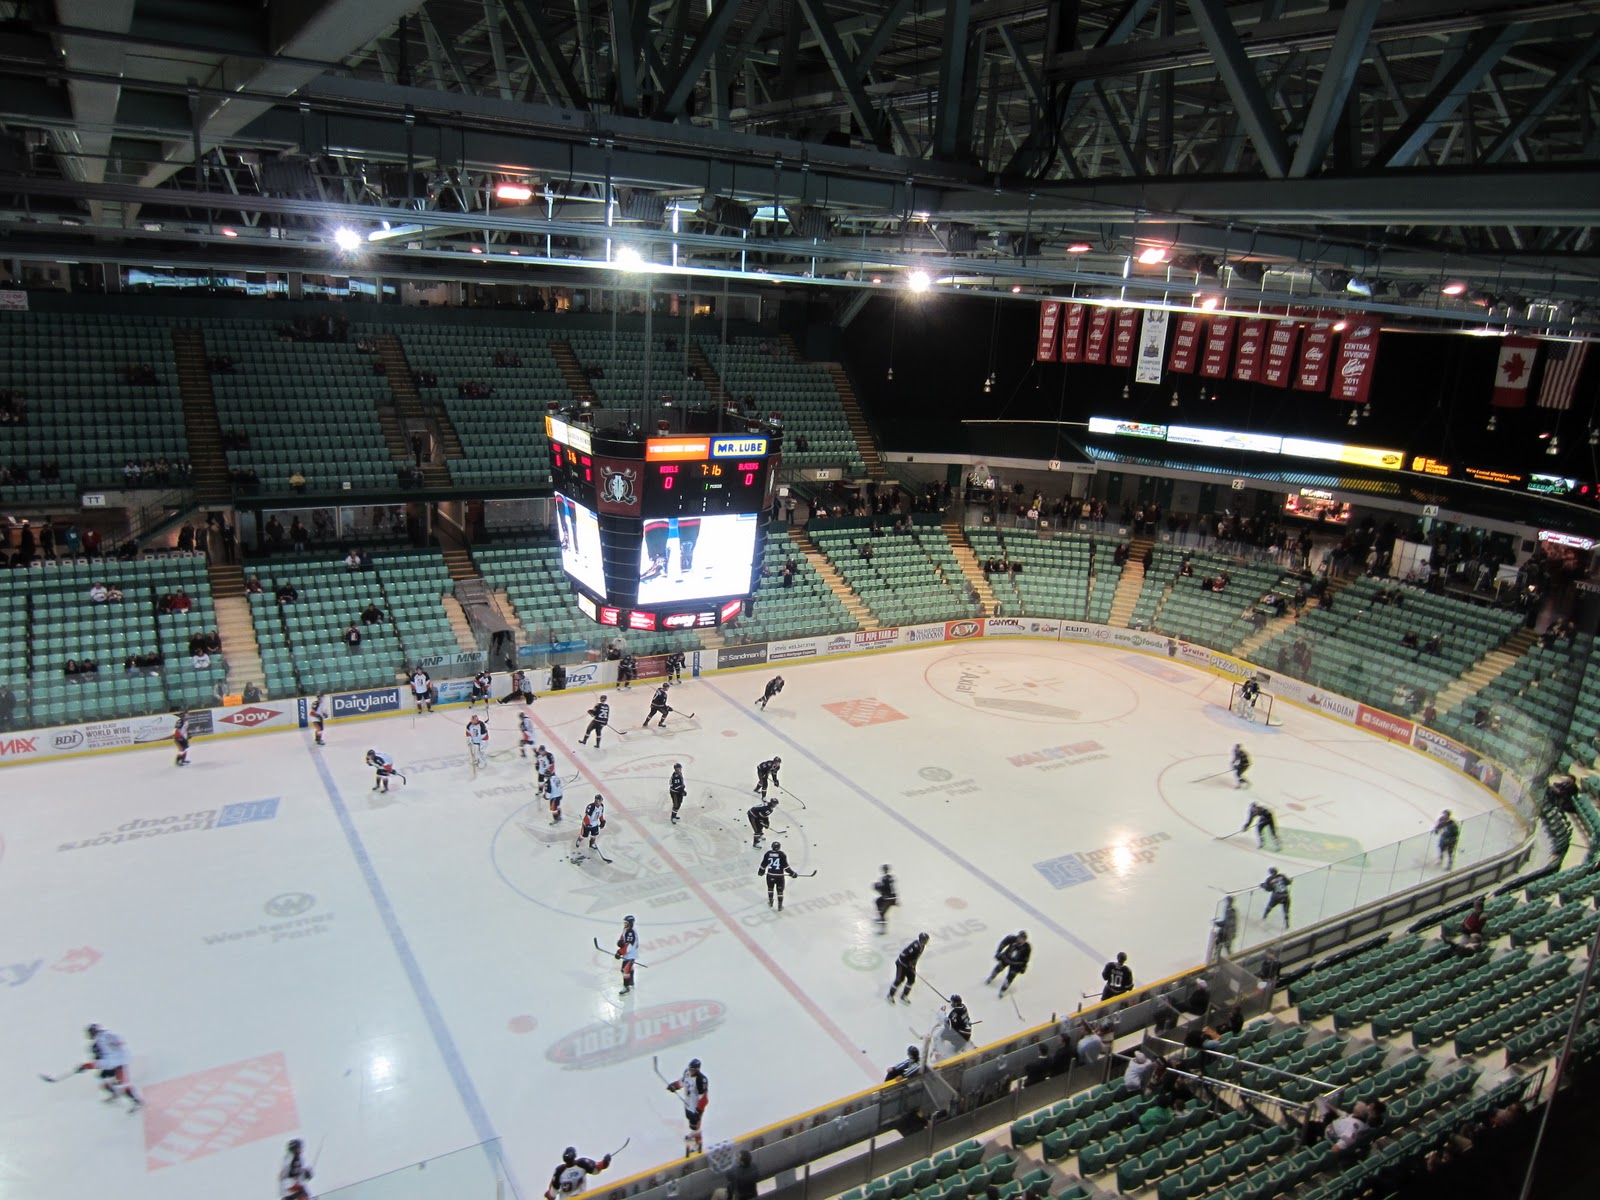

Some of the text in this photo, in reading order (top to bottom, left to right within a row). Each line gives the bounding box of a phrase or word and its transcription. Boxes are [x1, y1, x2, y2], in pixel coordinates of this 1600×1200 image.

[1344, 343, 1371, 351] CENTRAL
[1343, 351, 1370, 359] DIVISION
[718, 443, 762, 453] MR. LUBE
[702, 464, 721, 475] 7:16
[664, 477, 673, 489] 0
[745, 474, 753, 485] 0
[87, 496, 101, 504] TT
[924, 626, 944, 634] WEATHER
[952, 622, 976, 637] A&W
[856, 633, 865, 642] THE
[865, 632, 878, 641] PIPE
[915, 632, 944, 641] WINDOWS
[457, 653, 481, 663] MNP
[729, 652, 759, 661] Sandman
[1182, 645, 1210, 659] Bruin's
[420, 656, 443, 667] MNP
[1211, 656, 1238, 674] PIZZA
[1241, 667, 1253, 679] 73
[335, 692, 397, 712] Dairyland
[1319, 697, 1355, 718] CANADIAN
[86, 729, 112, 738] WORLD
[113, 726, 131, 735] WIDE
[1417, 728, 1447, 746] BOYD
[55, 734, 77, 746] BDI
[55, 817, 216, 854] Investors
[1075, 831, 1171, 864] Invtors
[768, 857, 781, 870] 24
[201, 911, 335, 946] Westerner
[271, 924, 329, 944] Park
[636, 922, 721, 953] NMAX
[882, 918, 989, 957] SVUS
[1110, 973, 1123, 987] 10
[633, 1005, 710, 1042] drive
